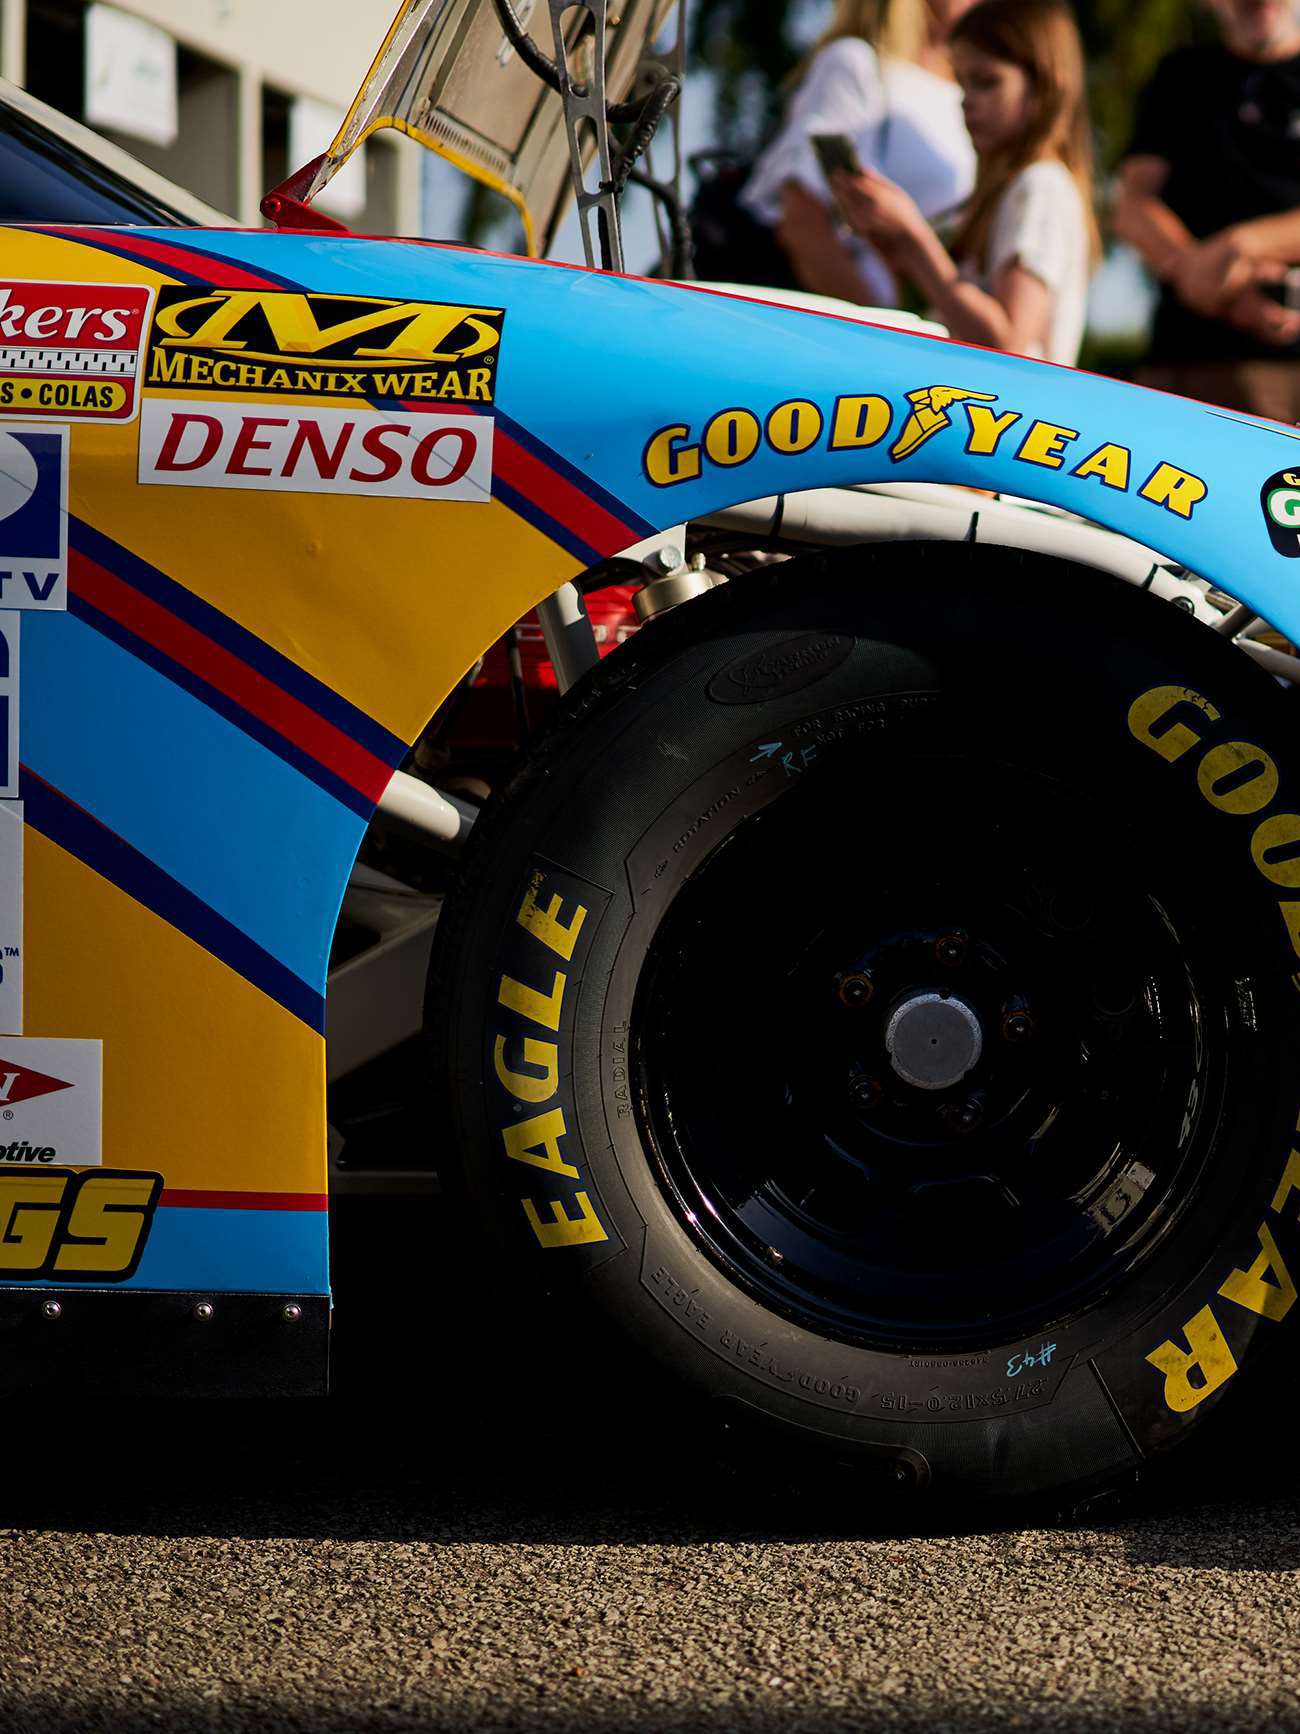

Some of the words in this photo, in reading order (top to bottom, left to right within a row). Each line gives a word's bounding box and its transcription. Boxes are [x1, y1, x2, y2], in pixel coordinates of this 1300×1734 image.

[39, 383, 113, 408] COLAS
[148, 346, 367, 394] MECHANIX
[371, 366, 493, 401] WEAR
[153, 412, 478, 487] DENSO
[495, 872, 610, 1249] EAGLE
[611, 1019, 633, 1120] RADIAL
[651, 1266, 715, 1330] EAGLE
[1005, 1341, 1058, 1378] #43
